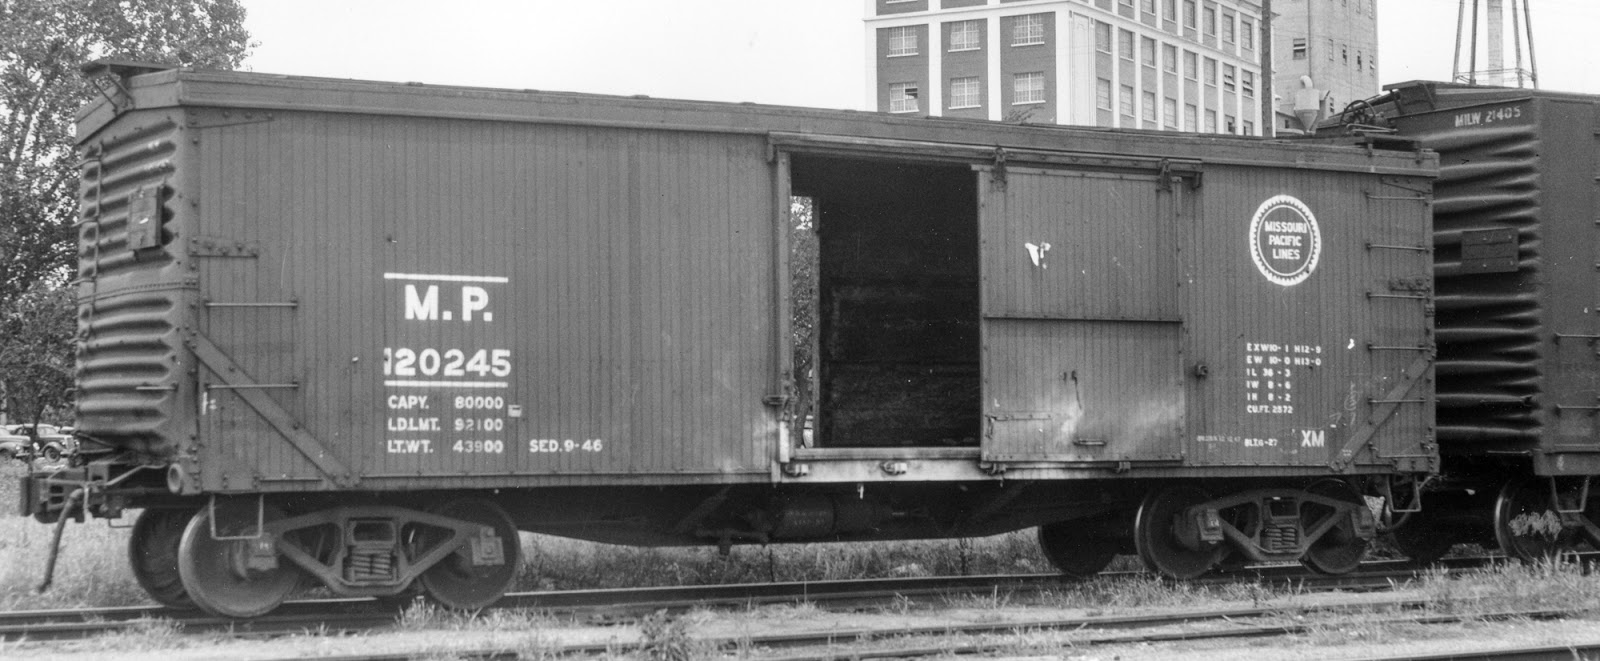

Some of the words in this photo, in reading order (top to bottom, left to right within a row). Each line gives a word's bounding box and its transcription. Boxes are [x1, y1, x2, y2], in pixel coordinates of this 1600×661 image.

[1455, 112, 1481, 127] MILW
[1485, 106, 1521, 123] 21405
[1264, 220, 1307, 233] MISSOURI
[1268, 235, 1302, 246] PACIFIC
[1273, 249, 1300, 260] LINES
[384, 347, 511, 377] 120245
[387, 395, 429, 409] CAPY.
[454, 396, 504, 409] 80000
[454, 418, 504, 431] 92100
[1301, 430, 1325, 447] XM
[453, 440, 504, 454] 43900
